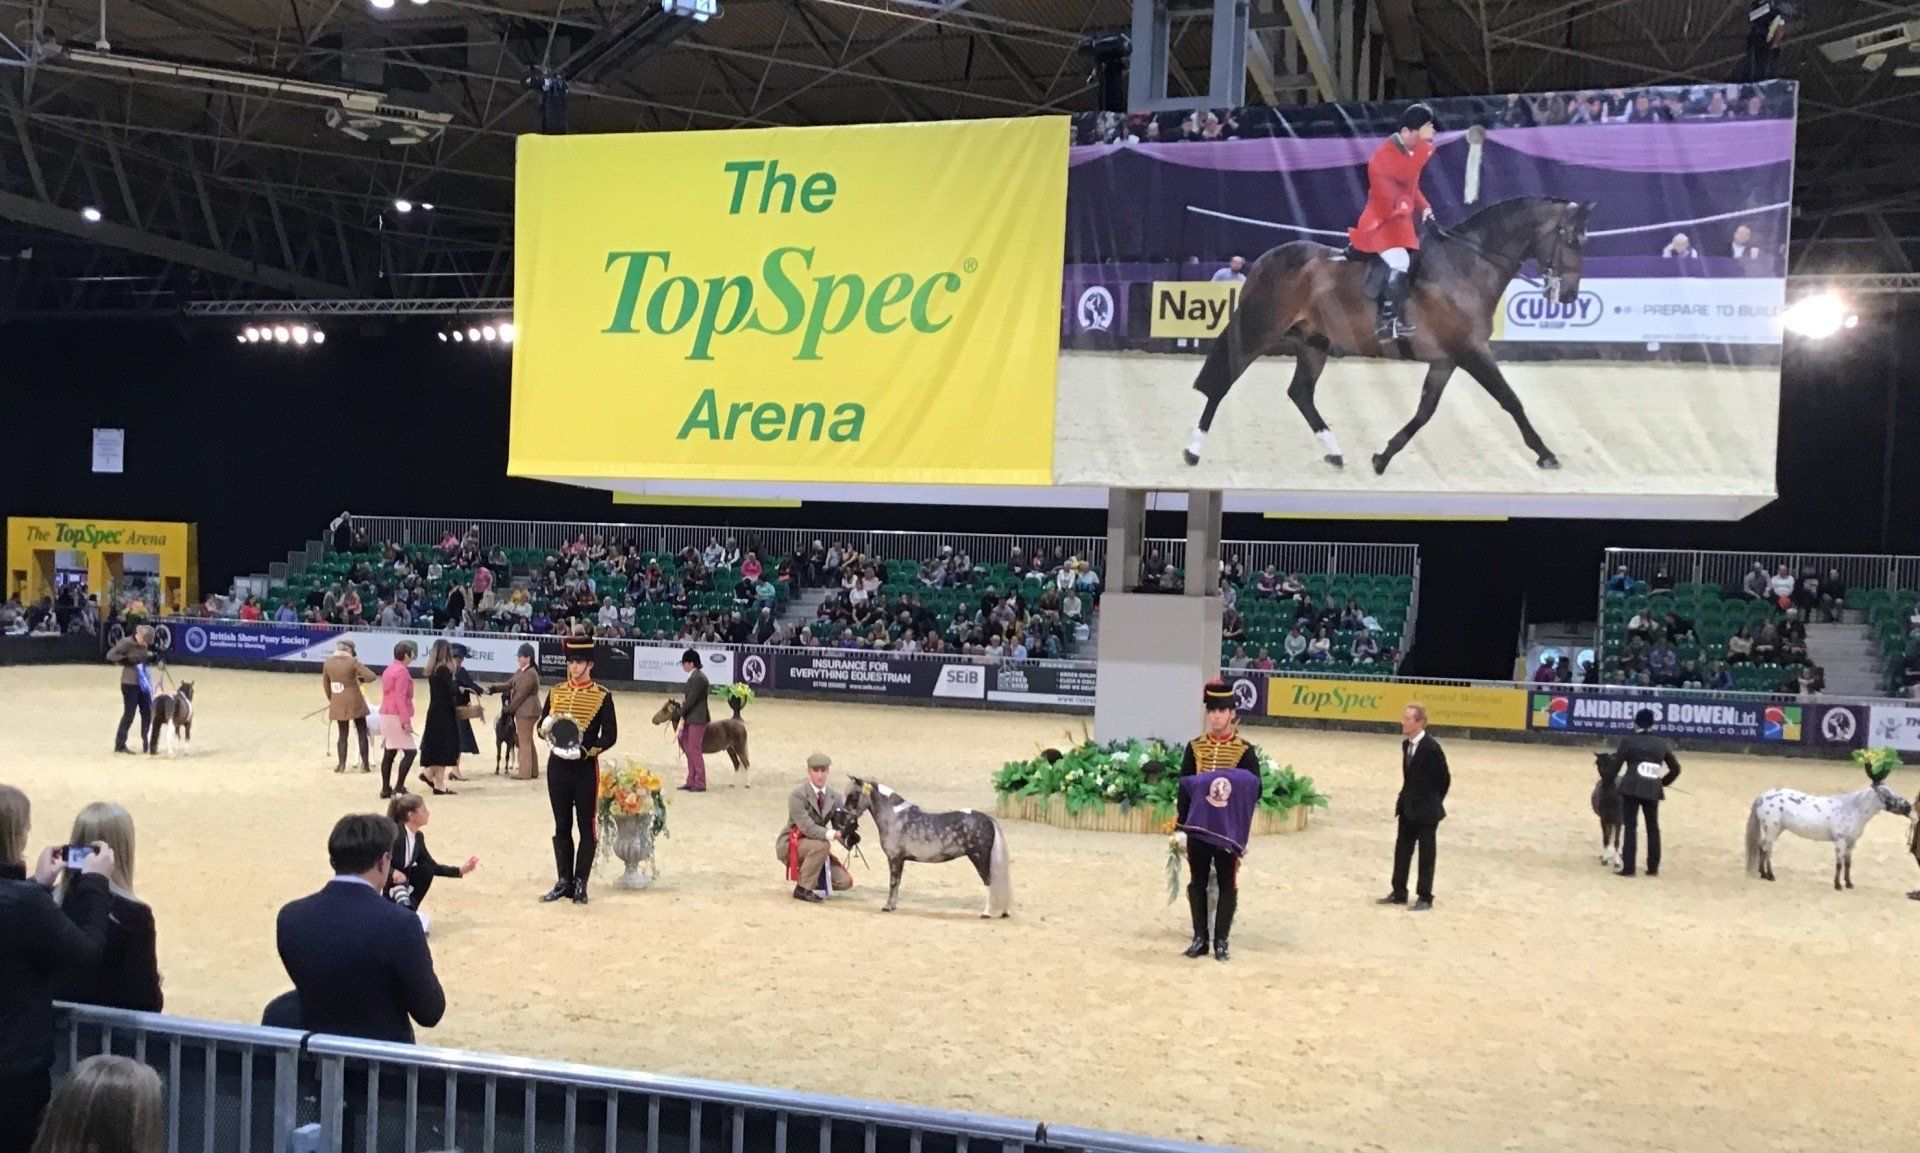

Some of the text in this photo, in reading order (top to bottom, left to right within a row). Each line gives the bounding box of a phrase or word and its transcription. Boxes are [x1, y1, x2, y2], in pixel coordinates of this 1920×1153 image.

[724, 159, 837, 215] The
[1516, 298, 1592, 319] CUDDY
[1643, 304, 1710, 316] PREPARE
[1716, 305, 1734, 317] TO
[676, 388, 865, 442] Arena
[27, 525, 50, 542] The
[126, 530, 166, 546] Arena
[209, 632, 310, 646] British Show Pony Society
[812, 659, 889, 672] INSURANCE FOR
[790, 667, 911, 684] EVERYTHING EQUESTRIAN
[1291, 685, 1384, 713] TopSpec
[1573, 720, 1757, 736] www.andwsbowen.co.uk
